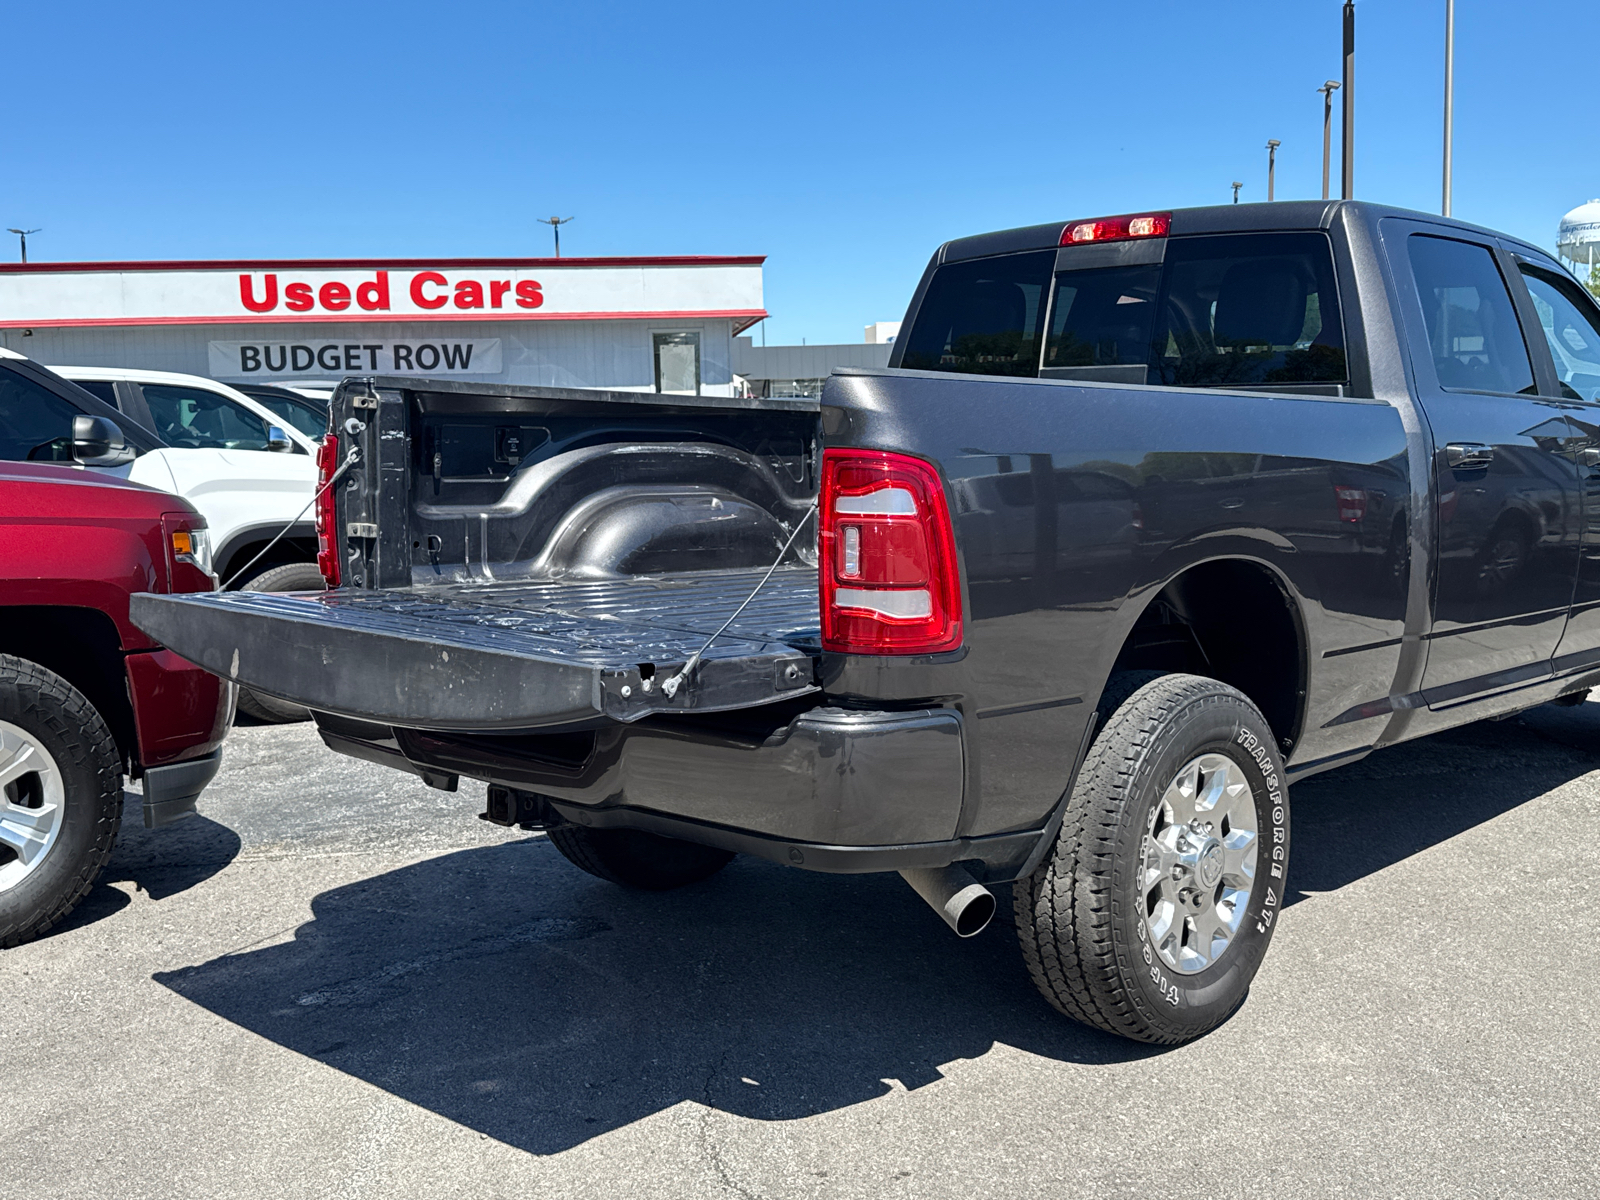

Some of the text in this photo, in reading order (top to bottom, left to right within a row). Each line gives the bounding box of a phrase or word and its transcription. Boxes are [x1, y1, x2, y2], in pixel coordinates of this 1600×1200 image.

[239, 270, 544, 313] Used Cars
[240, 343, 473, 372] BUDGET ROW
[1237, 728, 1285, 879] TRANSFORCE
